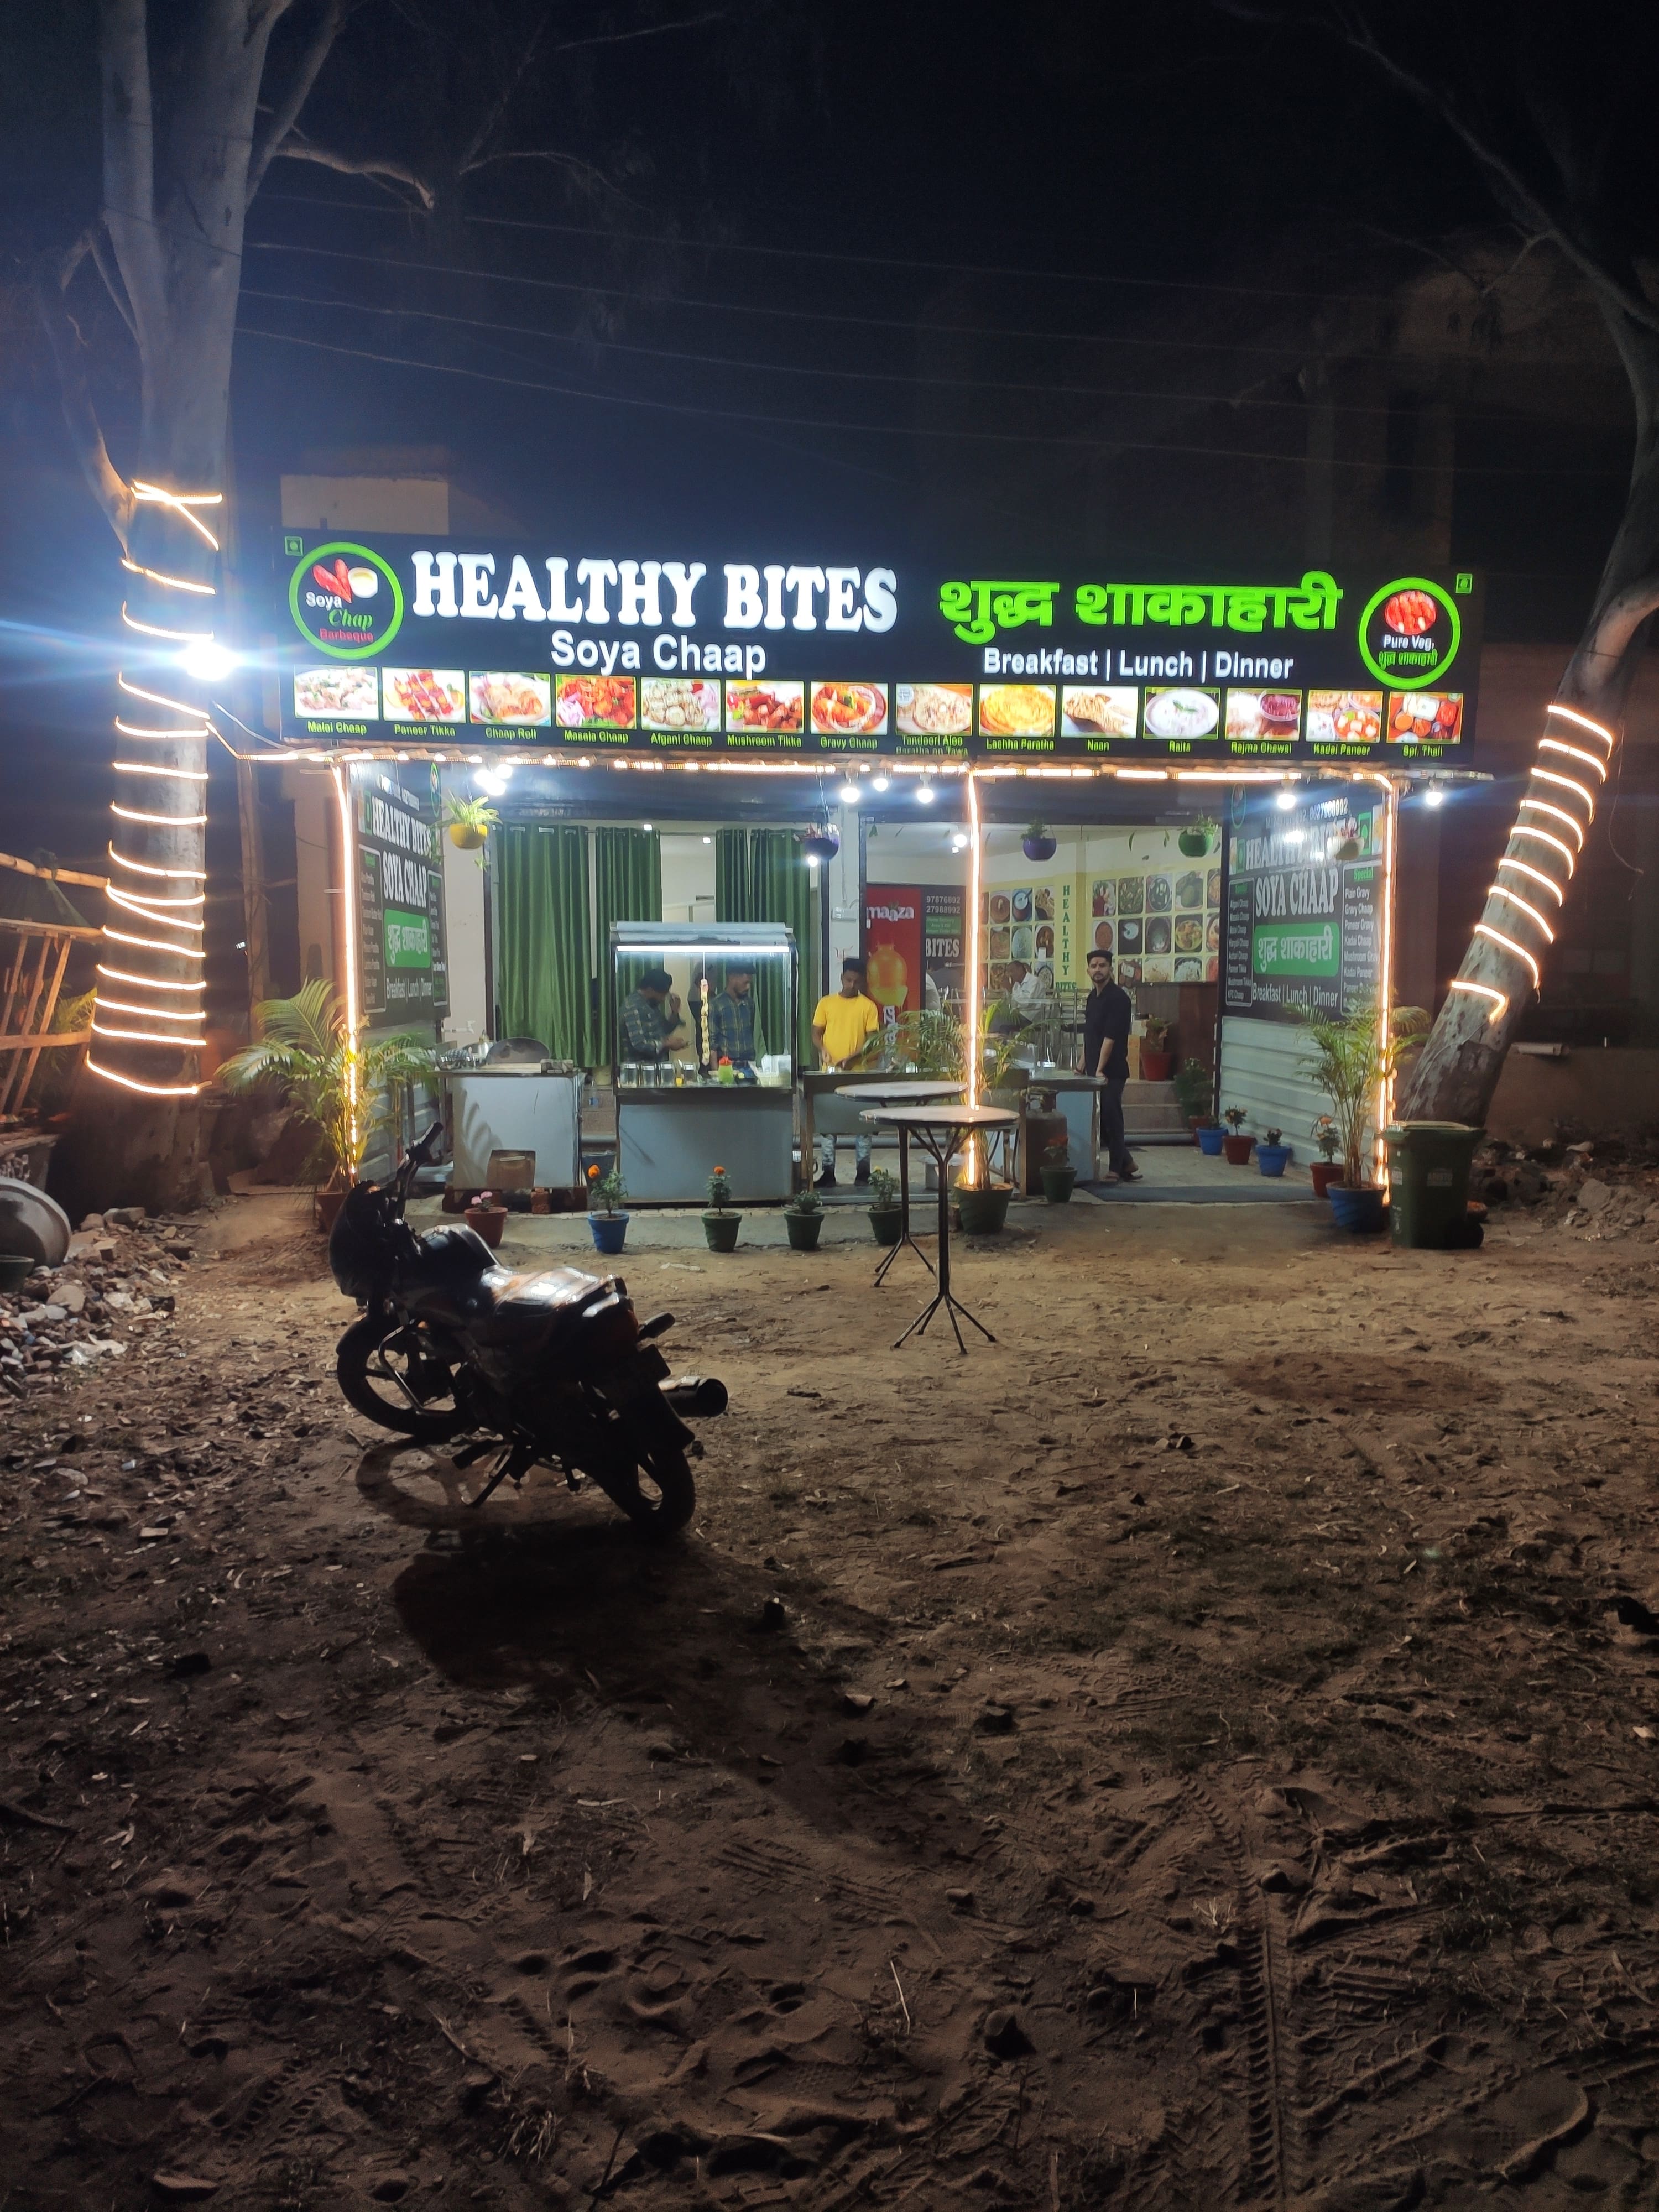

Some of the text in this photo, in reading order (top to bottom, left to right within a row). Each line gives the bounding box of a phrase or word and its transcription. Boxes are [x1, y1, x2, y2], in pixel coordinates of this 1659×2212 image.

[412, 551, 897, 632] HEALTHY BITES
[306, 592, 342, 611] Soya
[940, 571, 1344, 645] शुद्ध शाकाहारी
[328, 609, 373, 630] Chap
[320, 628, 374, 643] Barbeque
[1384, 634, 1408, 649] Pure
[551, 629, 766, 680] Soya Chaap
[984, 647, 1098, 676] Breakfast
[1120, 650, 1193, 677] Lunch
[1215, 651, 1294, 679] Dinner
[307, 721, 367, 735] Malai Chaap
[394, 724, 456, 737] Paneer Tikka
[485, 727, 536, 740] Chaap Roll
[564, 730, 629, 744] Masala Chaap
[650, 733, 712, 747] Afgani Chaap
[727, 734, 801, 747] Mushroom Tikka
[820, 736, 877, 750] Gravy Chaap
[902, 735, 963, 746] Tandoori Aloo
[1021, 739, 1054, 751] Paratha
[1087, 739, 1109, 752] Naan
[1170, 740, 1191, 753] Raita
[1231, 742, 1292, 754] Rajma Chawal
[1313, 743, 1370, 756] Kadai Paneer
[1422, 745, 1442, 757] Thali
[372, 796, 410, 851] HEALTHY
[383, 850, 427, 909] SOYA CHAAP
[1354, 867, 1374, 880] Special
[1255, 865, 1339, 917] SOYA CHAAP
[1345, 886, 1370, 901] Plain Gravy
[866, 906, 915, 922] maaza
[1344, 902, 1373, 916] Gravy Chaap
[1344, 918, 1374, 932] Paneer Gravy
[926, 938, 960, 957] BITES
[1258, 924, 1333, 972] शुद्ध शाकाहारी
[1344, 935, 1372, 947] Kadai Chaap
[1344, 951, 1366, 962] Mushroom
[1357, 967, 1373, 978] Paneer
[387, 977, 405, 999] Breakfast
[1253, 983, 1281, 1002] Breakfast
[1286, 985, 1307, 1005] Lunch
[1313, 985, 1338, 1008] Dinner
